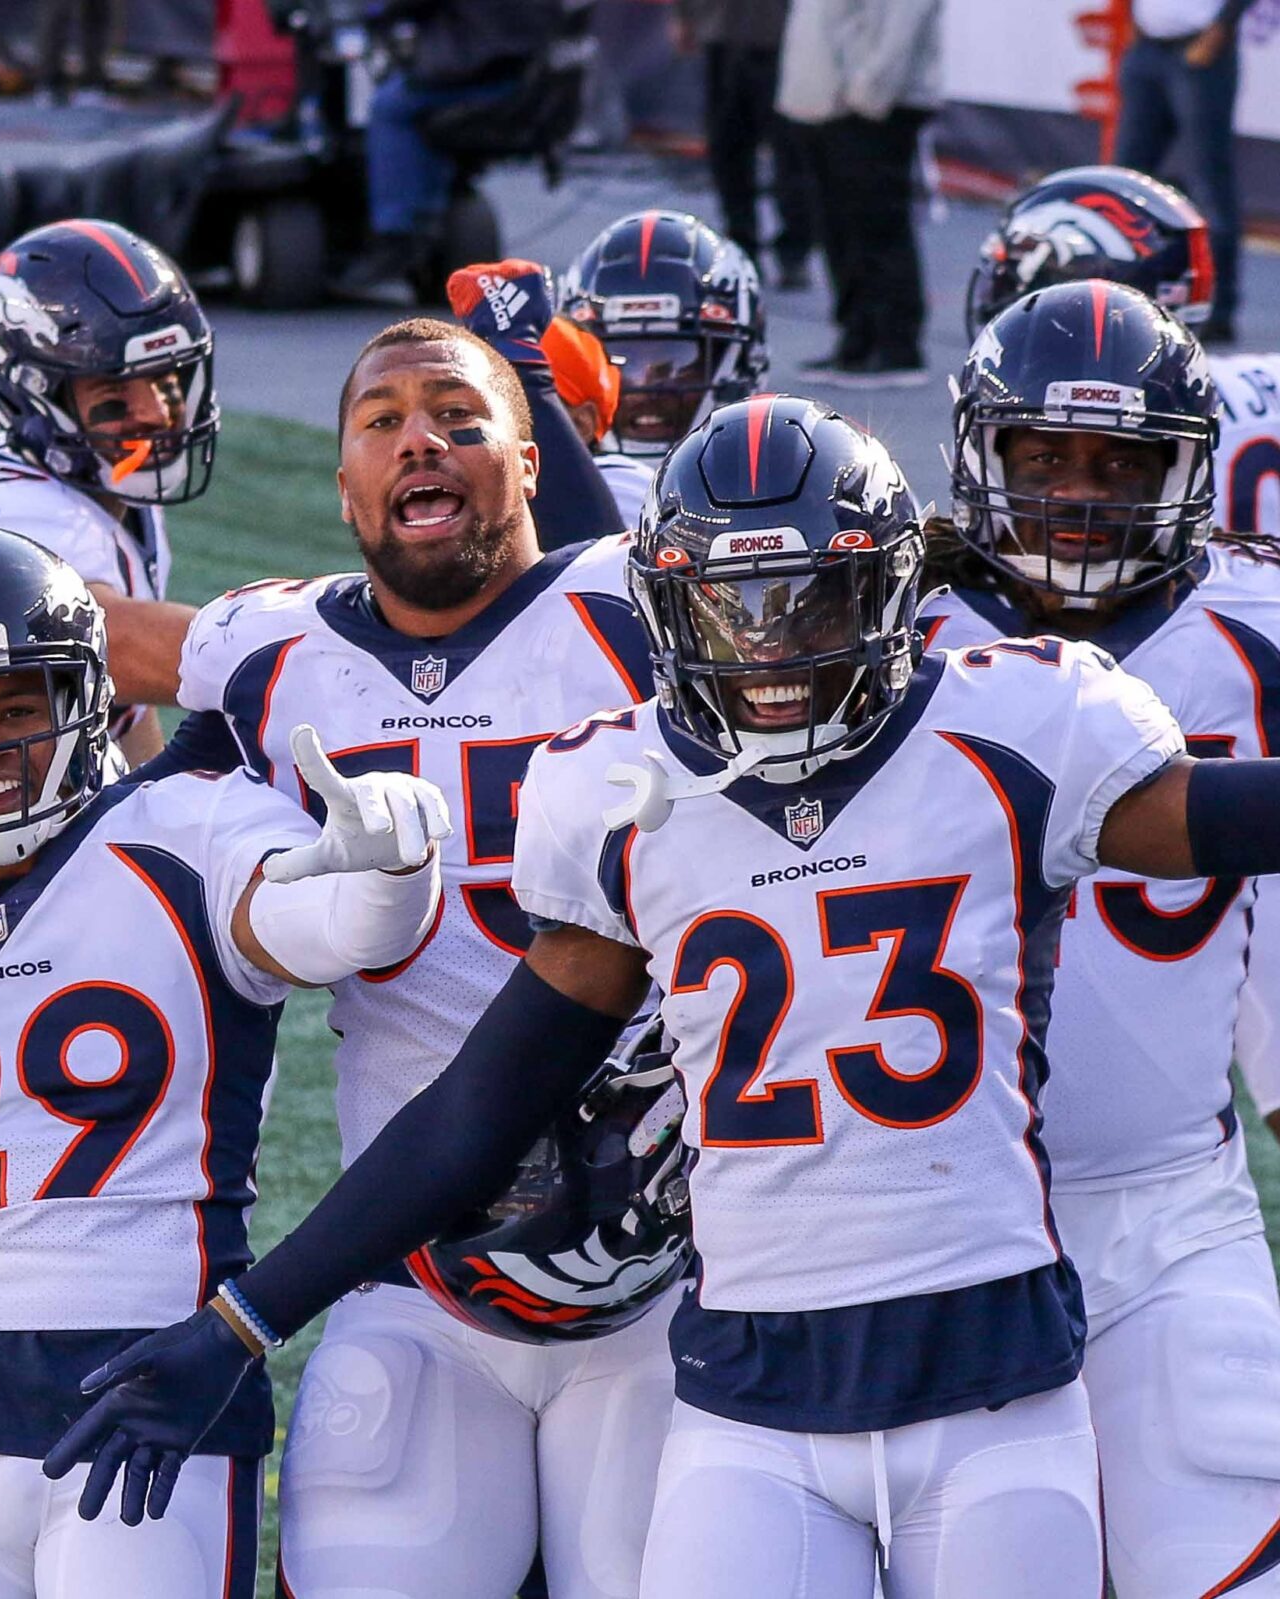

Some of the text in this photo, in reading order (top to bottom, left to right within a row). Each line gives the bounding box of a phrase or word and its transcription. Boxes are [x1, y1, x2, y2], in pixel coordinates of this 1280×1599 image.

[477, 274, 511, 331] adidas
[1070, 387, 1121, 403] BRONCOS
[730, 535, 783, 553] BRONCOS
[417, 673, 439, 689] NFL
[381, 715, 492, 729] BRONCOS
[793, 817, 817, 835] NFL
[751, 855, 867, 887] BRONCOS
[670, 874, 985, 1147] 23
